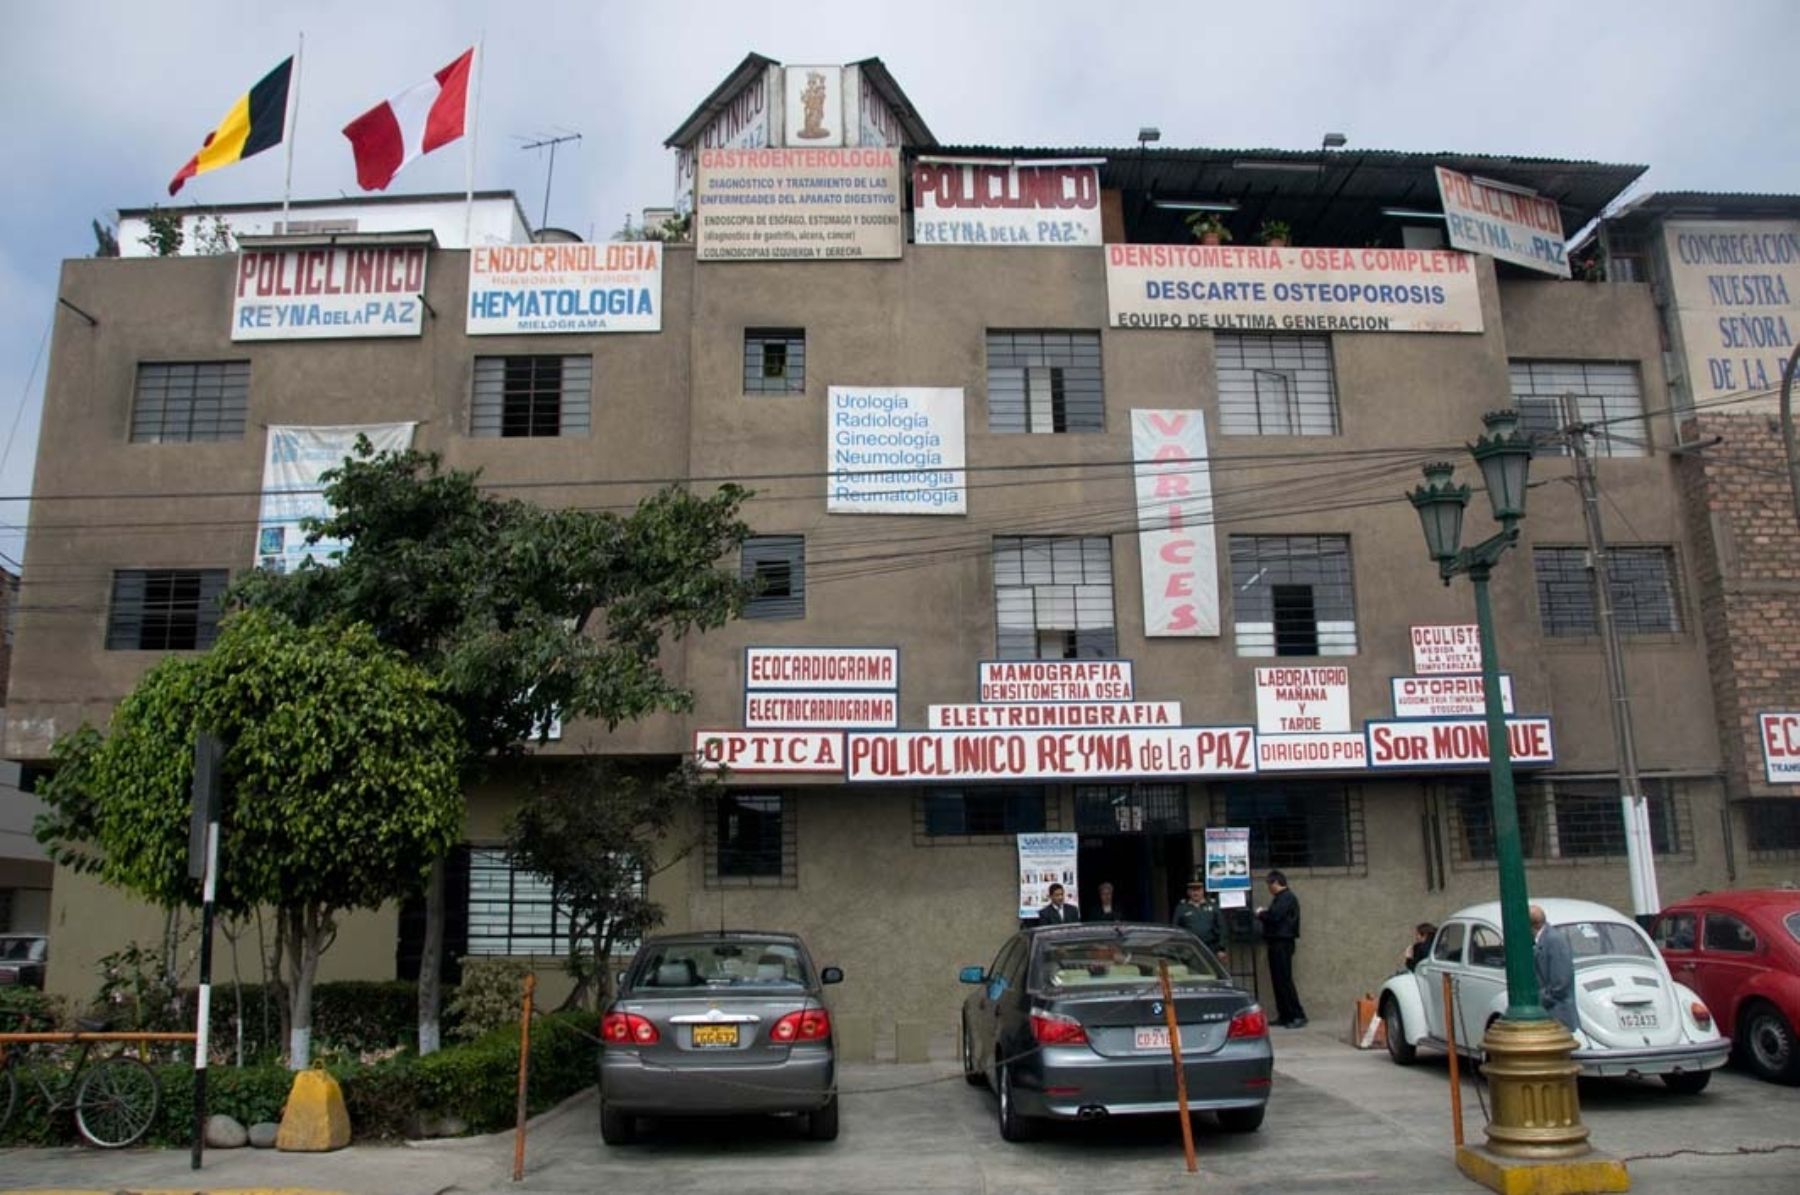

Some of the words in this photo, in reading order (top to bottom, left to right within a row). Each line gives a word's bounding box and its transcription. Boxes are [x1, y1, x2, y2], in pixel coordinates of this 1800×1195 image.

[777, 179, 784, 188] Y
[787, 178, 851, 188] TRATAMIENTO
[854, 178, 867, 188] DE
[869, 178, 887, 188] LAS
[915, 164, 1098, 209] POLICLINICO
[778, 194, 796, 204] DEL
[799, 193, 842, 204] APARATO
[1440, 171, 1560, 234] POLICLINICO
[1449, 211, 1512, 250] REYNA
[1531, 235, 1566, 266] PAZ
[1678, 233, 1800, 265] CONGREGACION
[473, 244, 657, 273] ENDOCRINOLOGIA
[1301, 249, 1355, 270] OSEA
[1362, 250, 1469, 273] COMPLETA
[238, 249, 424, 297] POLICLINICO
[1146, 281, 1266, 300] DESCARTE
[1273, 283, 1445, 304] OSTEOPOROSIS
[1708, 274, 1790, 305] NUESTRA
[240, 303, 320, 328] REYNA
[364, 302, 415, 324] PAZ
[471, 288, 652, 318] HEMATOLOGIA
[518, 319, 606, 330] MIELOGRAMA
[1118, 313, 1182, 327] EQUIPO
[1188, 314, 1208, 327] DE
[1215, 314, 1277, 328] ULTIMA
[1719, 312, 1793, 348] SEÑORA
[1709, 358, 1736, 389] DE
[1743, 359, 1770, 389] LA
[1149, 413, 1199, 631] VARICES
[751, 656, 893, 681] ECOCARDIOGRAMA
[989, 664, 1122, 681] MAMOGRAFIA
[1258, 669, 1346, 687] LABORATORIO
[982, 683, 1091, 699] DENSITOMETRIA
[1096, 683, 1131, 698] OSEA
[1276, 687, 1328, 700] MAÑANA
[749, 698, 893, 721] ELECTROCARDIOGRAMA
[940, 705, 1168, 726] ELECTROMIOGRAFIA
[1298, 703, 1307, 714] Y
[1280, 717, 1321, 730] TARDE
[704, 736, 836, 764] OPTICA
[852, 733, 1026, 777] POLICLINICO
[1037, 733, 1133, 773] REYNA
[1196, 730, 1251, 770] PAZ
[1261, 743, 1329, 762] DIRIGIDO
[1333, 741, 1364, 759] POR
